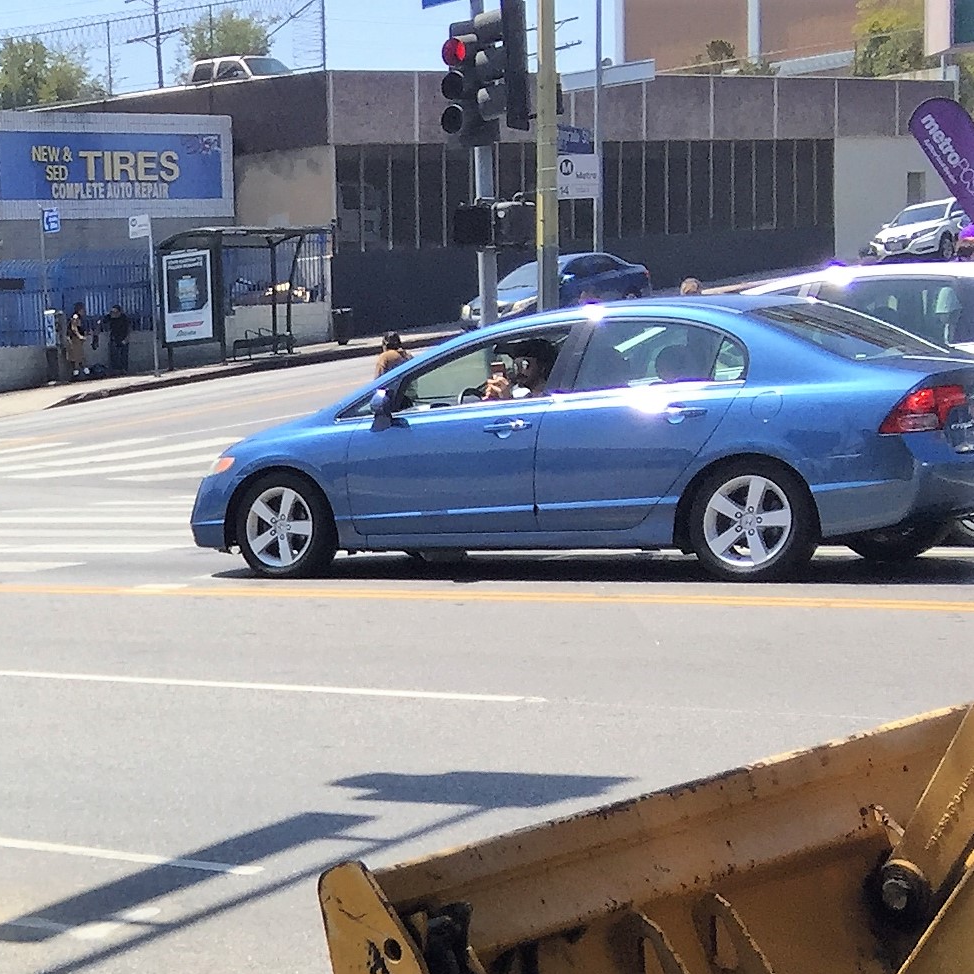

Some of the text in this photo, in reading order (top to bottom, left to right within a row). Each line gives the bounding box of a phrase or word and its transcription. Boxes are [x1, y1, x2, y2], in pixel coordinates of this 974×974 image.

[31, 146, 73, 162] NEW &
[79, 151, 181, 182] TIRES
[51, 182, 169, 199] COMPLETE AUTO REPAIR
